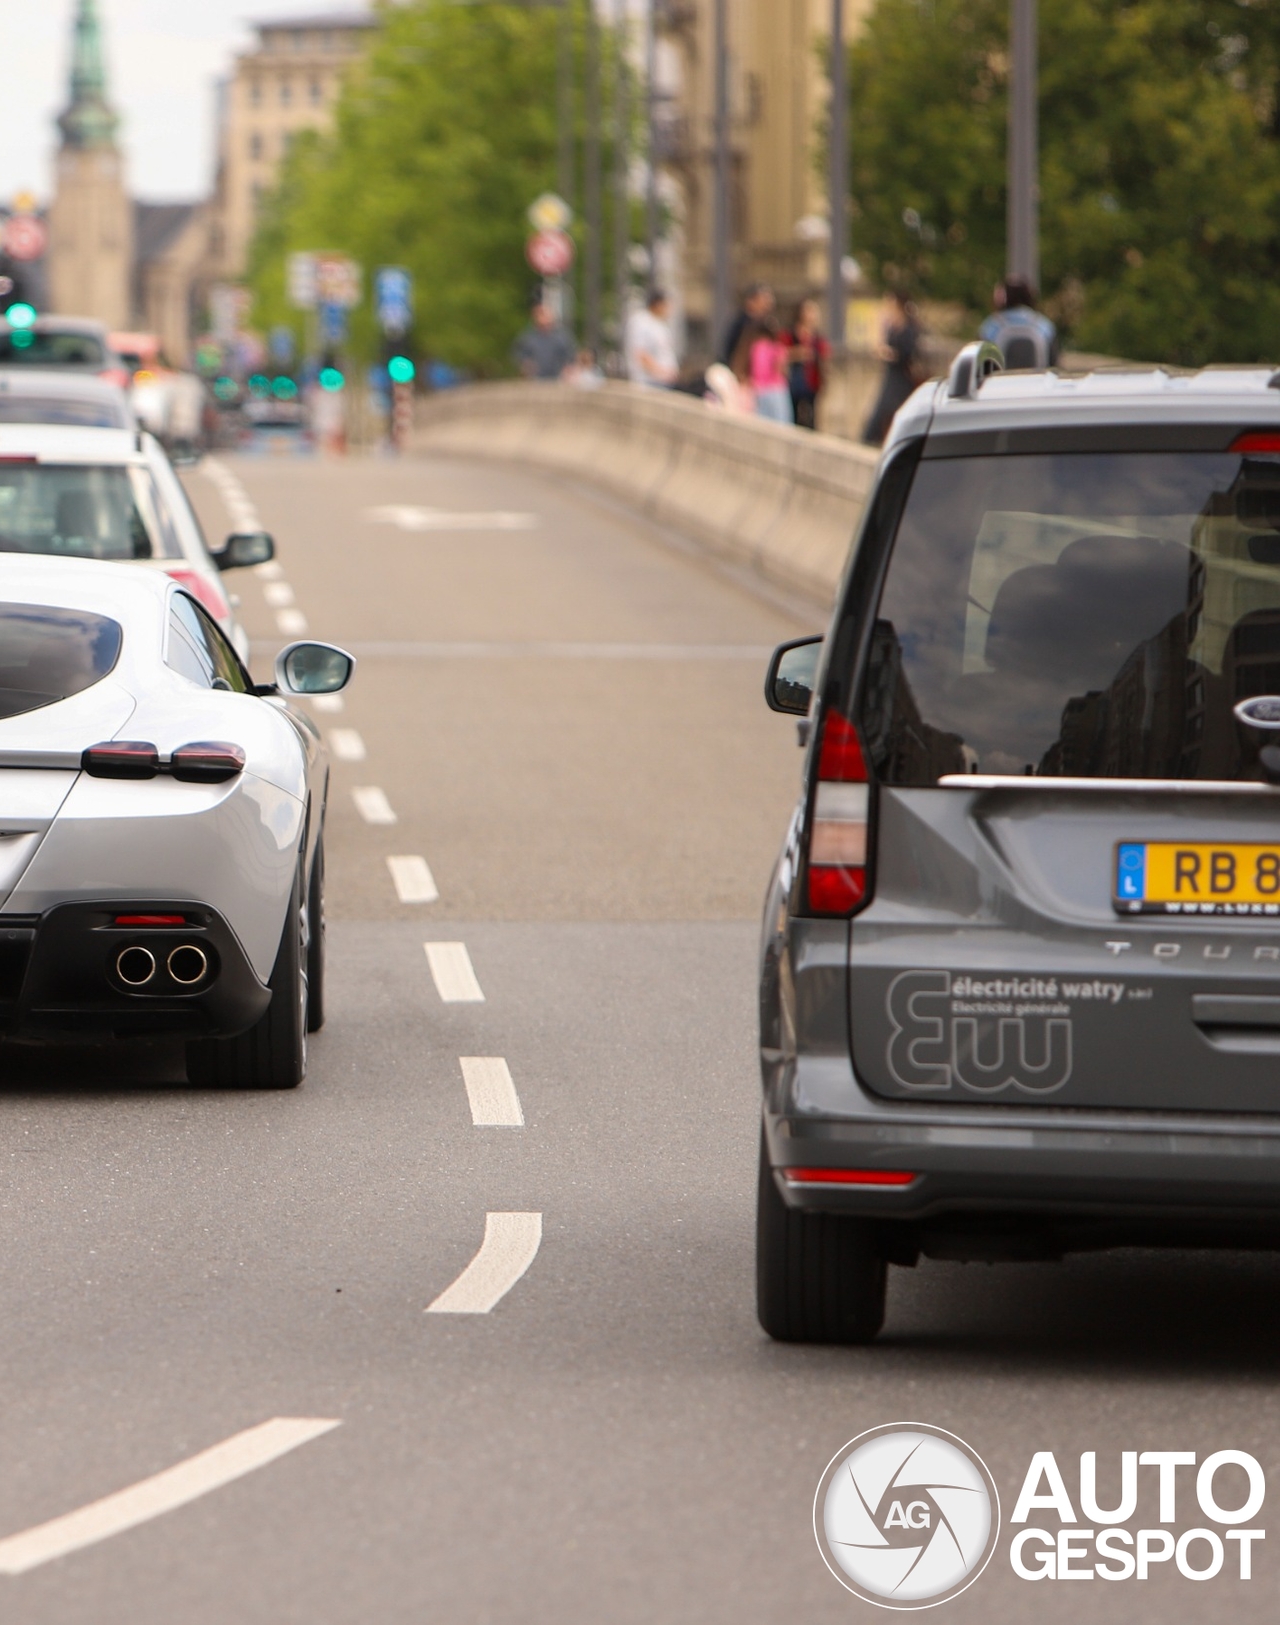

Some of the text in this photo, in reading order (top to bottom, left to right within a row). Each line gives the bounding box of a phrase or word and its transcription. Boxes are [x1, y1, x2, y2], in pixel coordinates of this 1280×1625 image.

[1124, 876, 1138, 894] L
[1174, 851, 1280, 895] RB 8
[952, 976, 1058, 998] électricité
[1062, 980, 1124, 1004] watry
